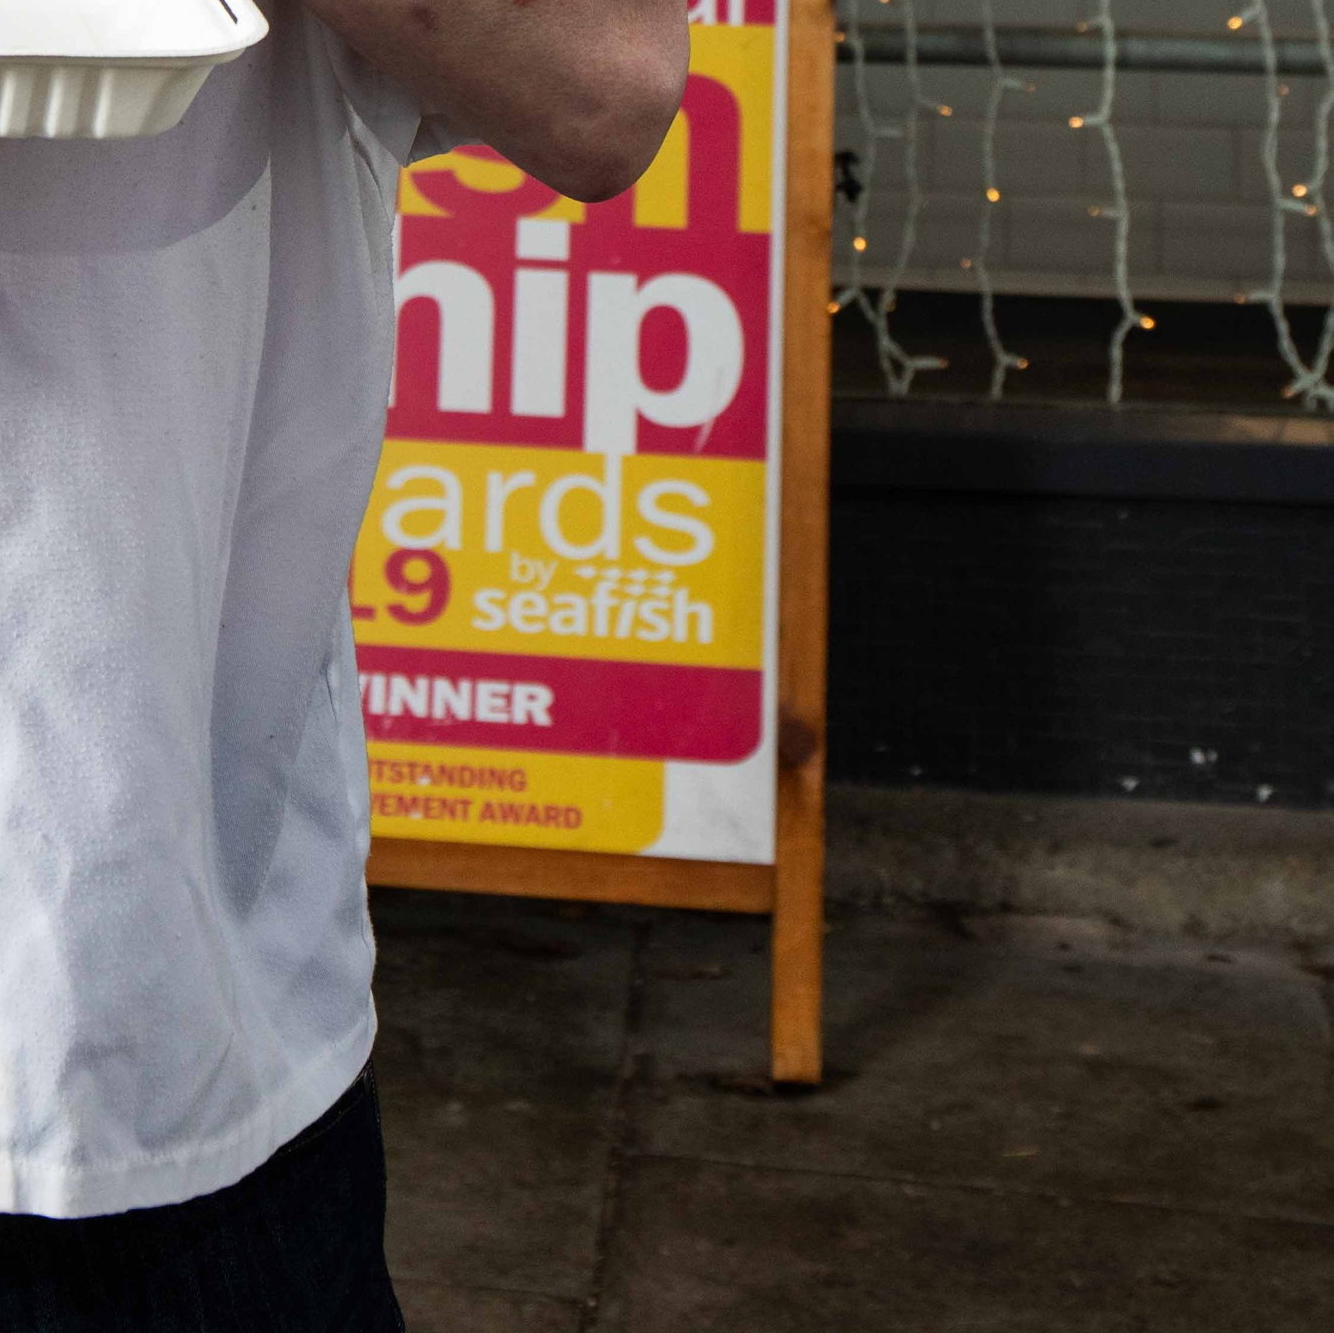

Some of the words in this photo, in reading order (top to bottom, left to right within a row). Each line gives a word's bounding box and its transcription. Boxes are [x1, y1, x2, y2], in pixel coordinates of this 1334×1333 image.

[508, 550, 558, 591] by
[471, 580, 715, 644] seafish
[360, 672, 554, 727] INNER
[369, 760, 527, 793] TSTANDING
[478, 800, 583, 830] AWARD
